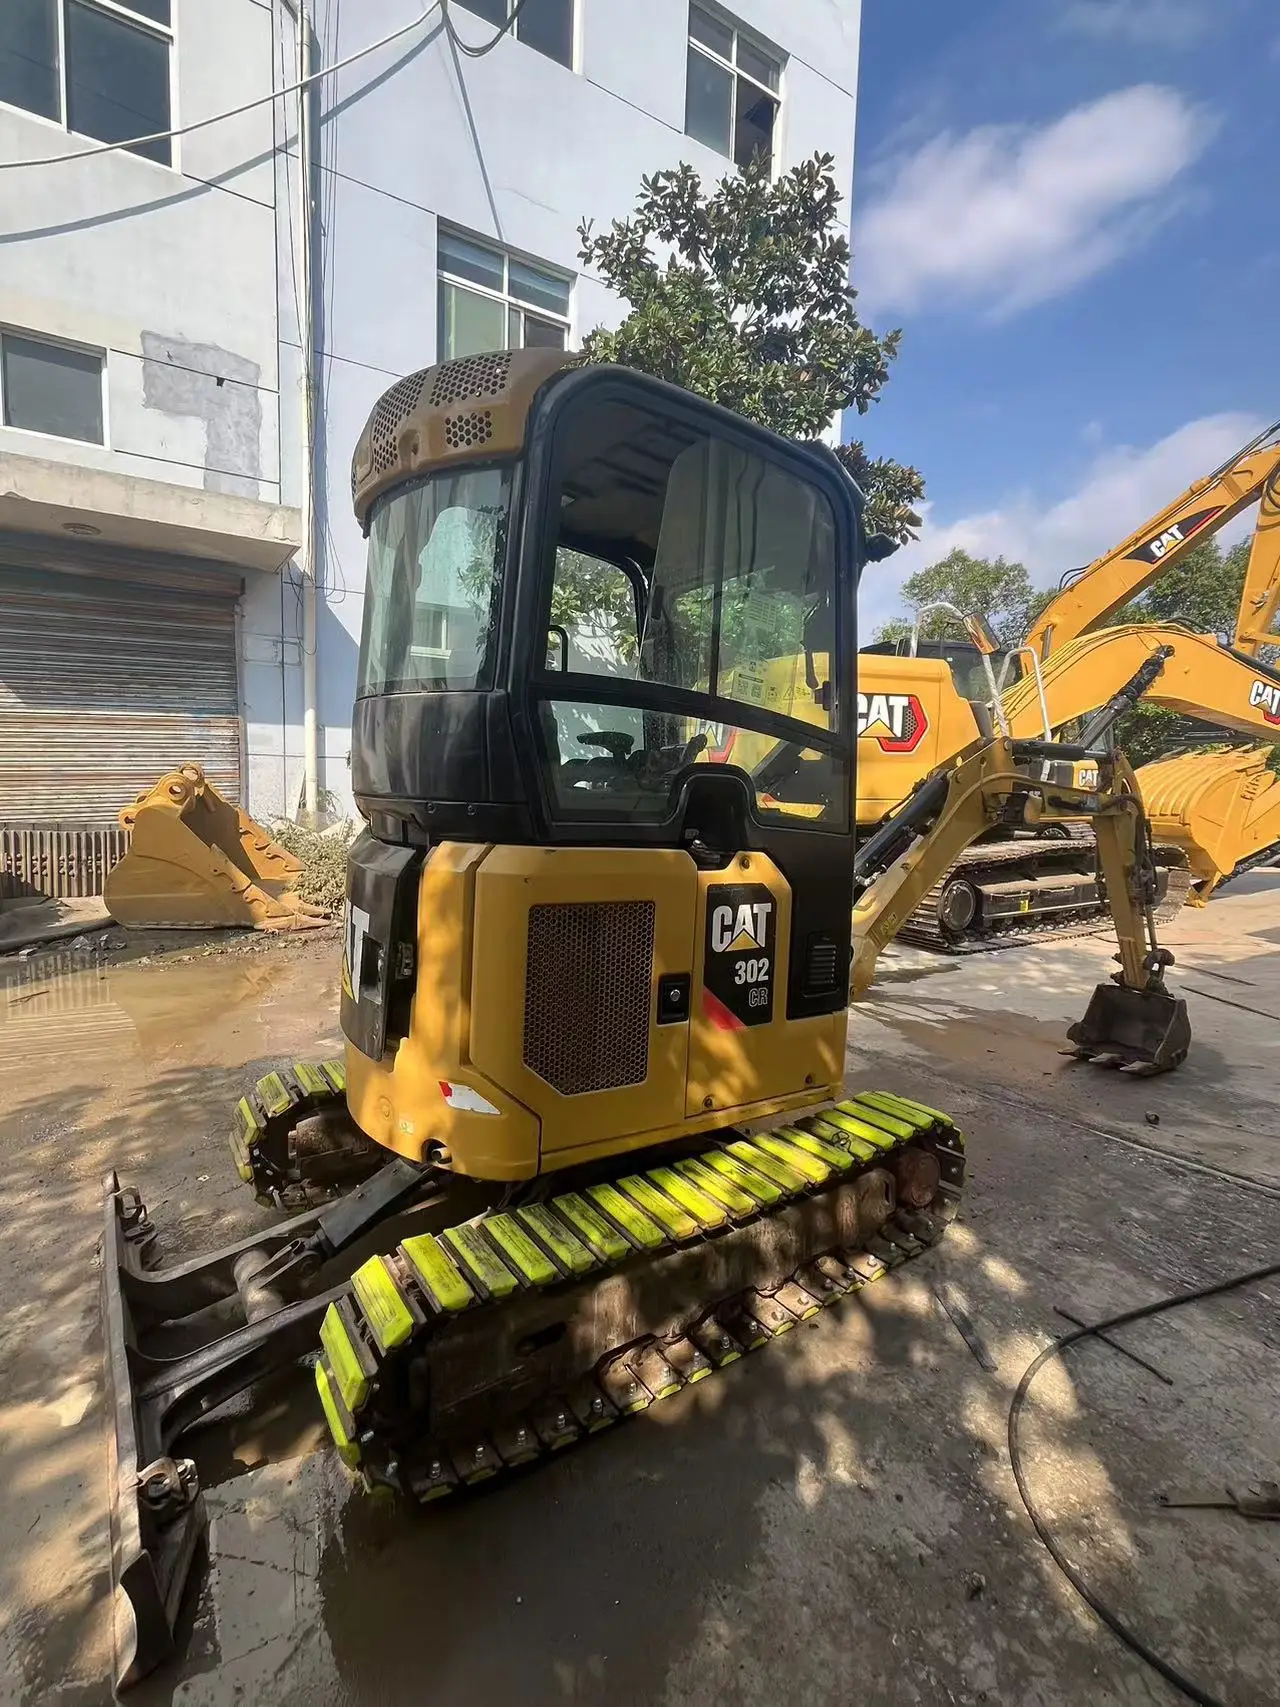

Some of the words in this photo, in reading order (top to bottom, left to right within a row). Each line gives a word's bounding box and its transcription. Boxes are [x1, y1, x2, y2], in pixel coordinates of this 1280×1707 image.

[1150, 524, 1184, 557] CAT
[1079, 769, 1098, 787] CAT
[712, 903, 771, 952] CAT
[734, 957, 770, 985] 302
[748, 987, 768, 1007] CR
